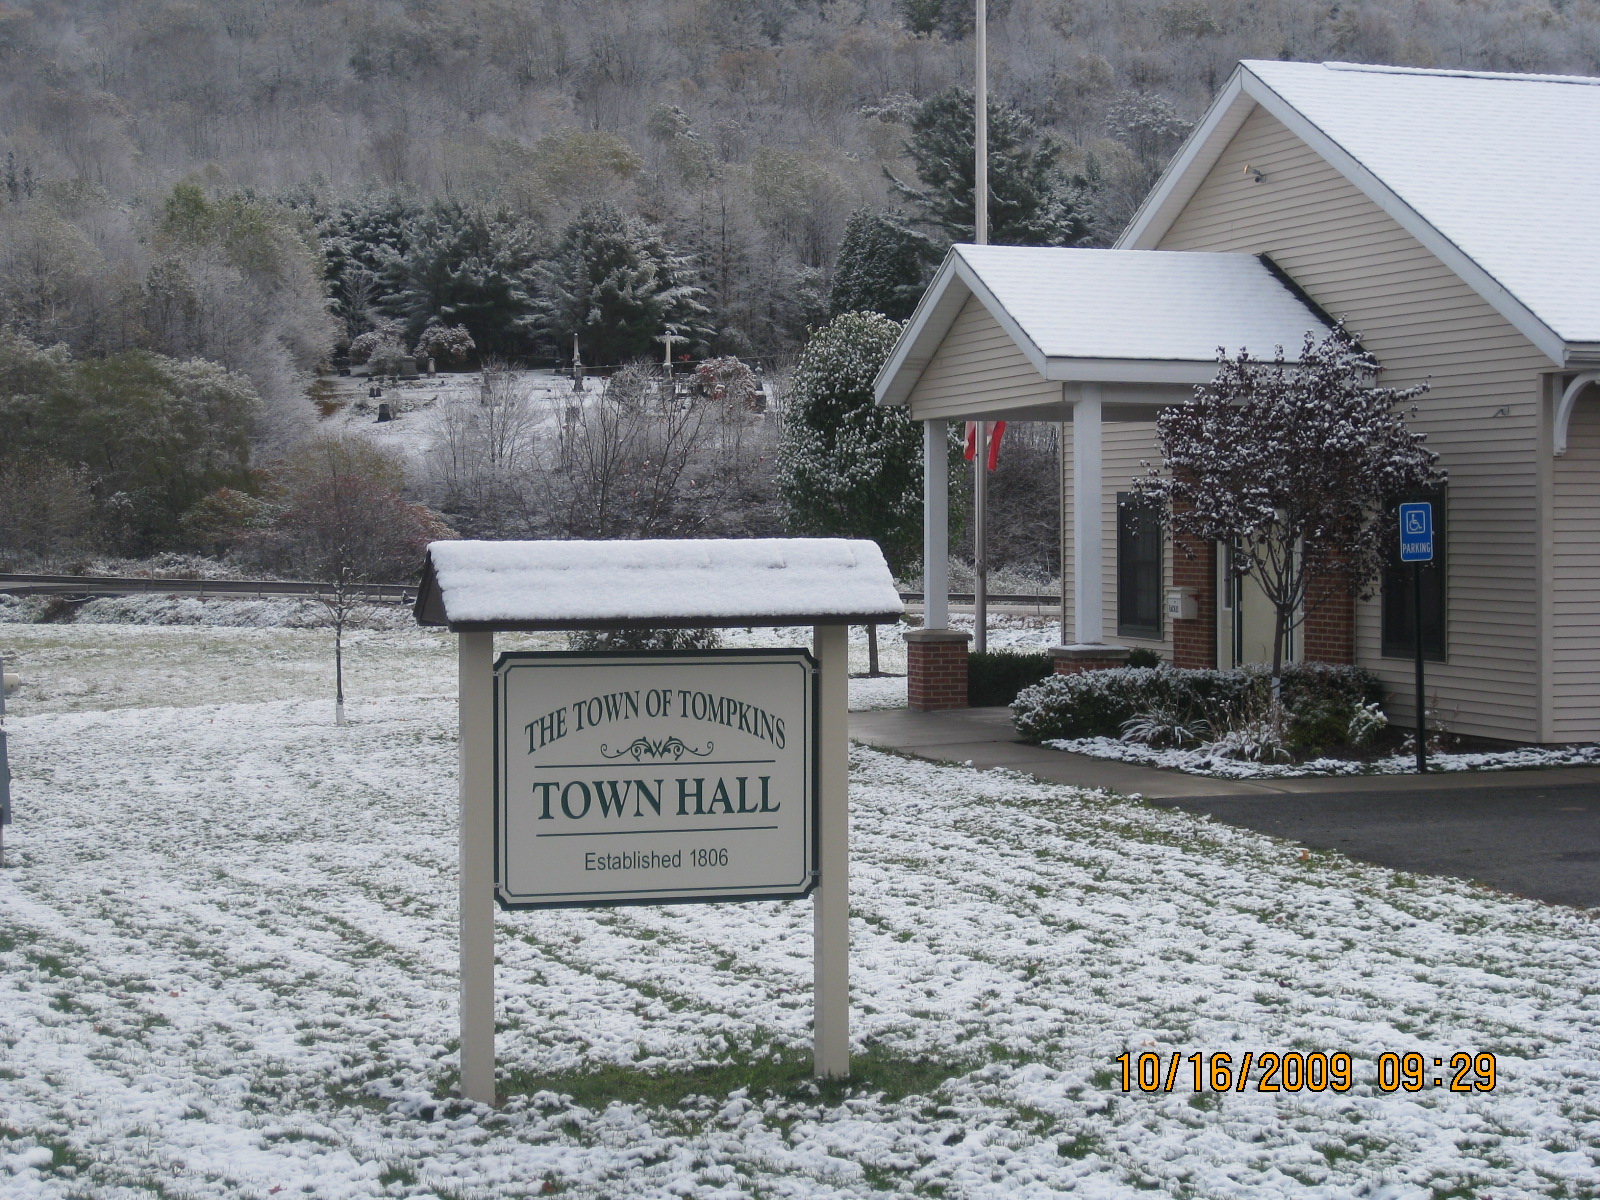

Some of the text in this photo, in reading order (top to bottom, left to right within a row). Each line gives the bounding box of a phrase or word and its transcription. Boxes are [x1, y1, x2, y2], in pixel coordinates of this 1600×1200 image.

[1402, 543, 1431, 554] PARKING
[524, 688, 786, 755] THE TOWN OF TOMPKINS
[532, 776, 781, 820] TOWN HALL
[584, 848, 729, 871] Established 1806
